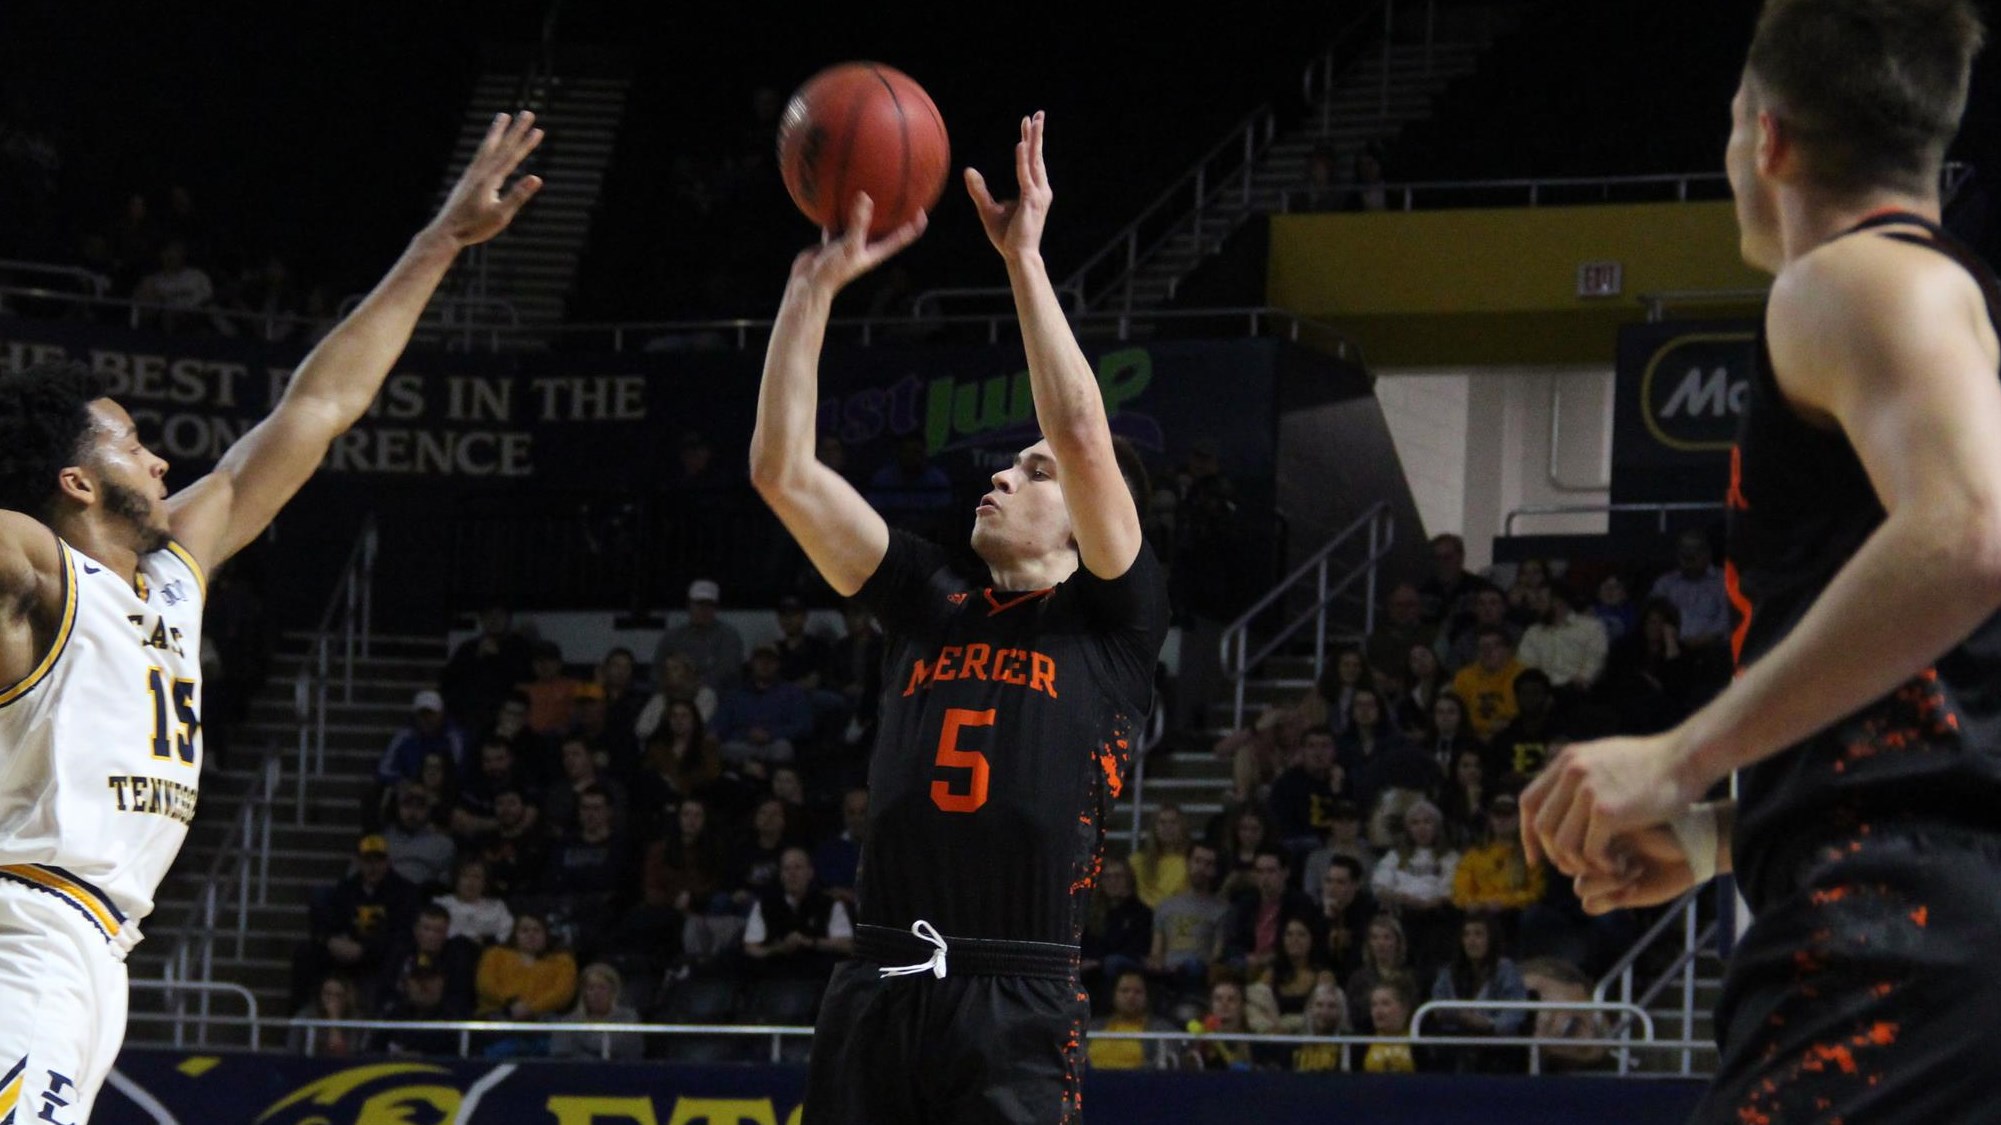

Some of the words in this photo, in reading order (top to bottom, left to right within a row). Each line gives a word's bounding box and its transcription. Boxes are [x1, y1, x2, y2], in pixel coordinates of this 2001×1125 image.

[88, 349, 248, 408] BEST
[446, 374, 514, 422] IN
[530, 375, 647, 422] THE
[131, 407, 536, 476] CONRENCE
[902, 643, 1059, 699] MERCER
[147, 666, 197, 766] 15
[931, 708, 997, 813] 5
